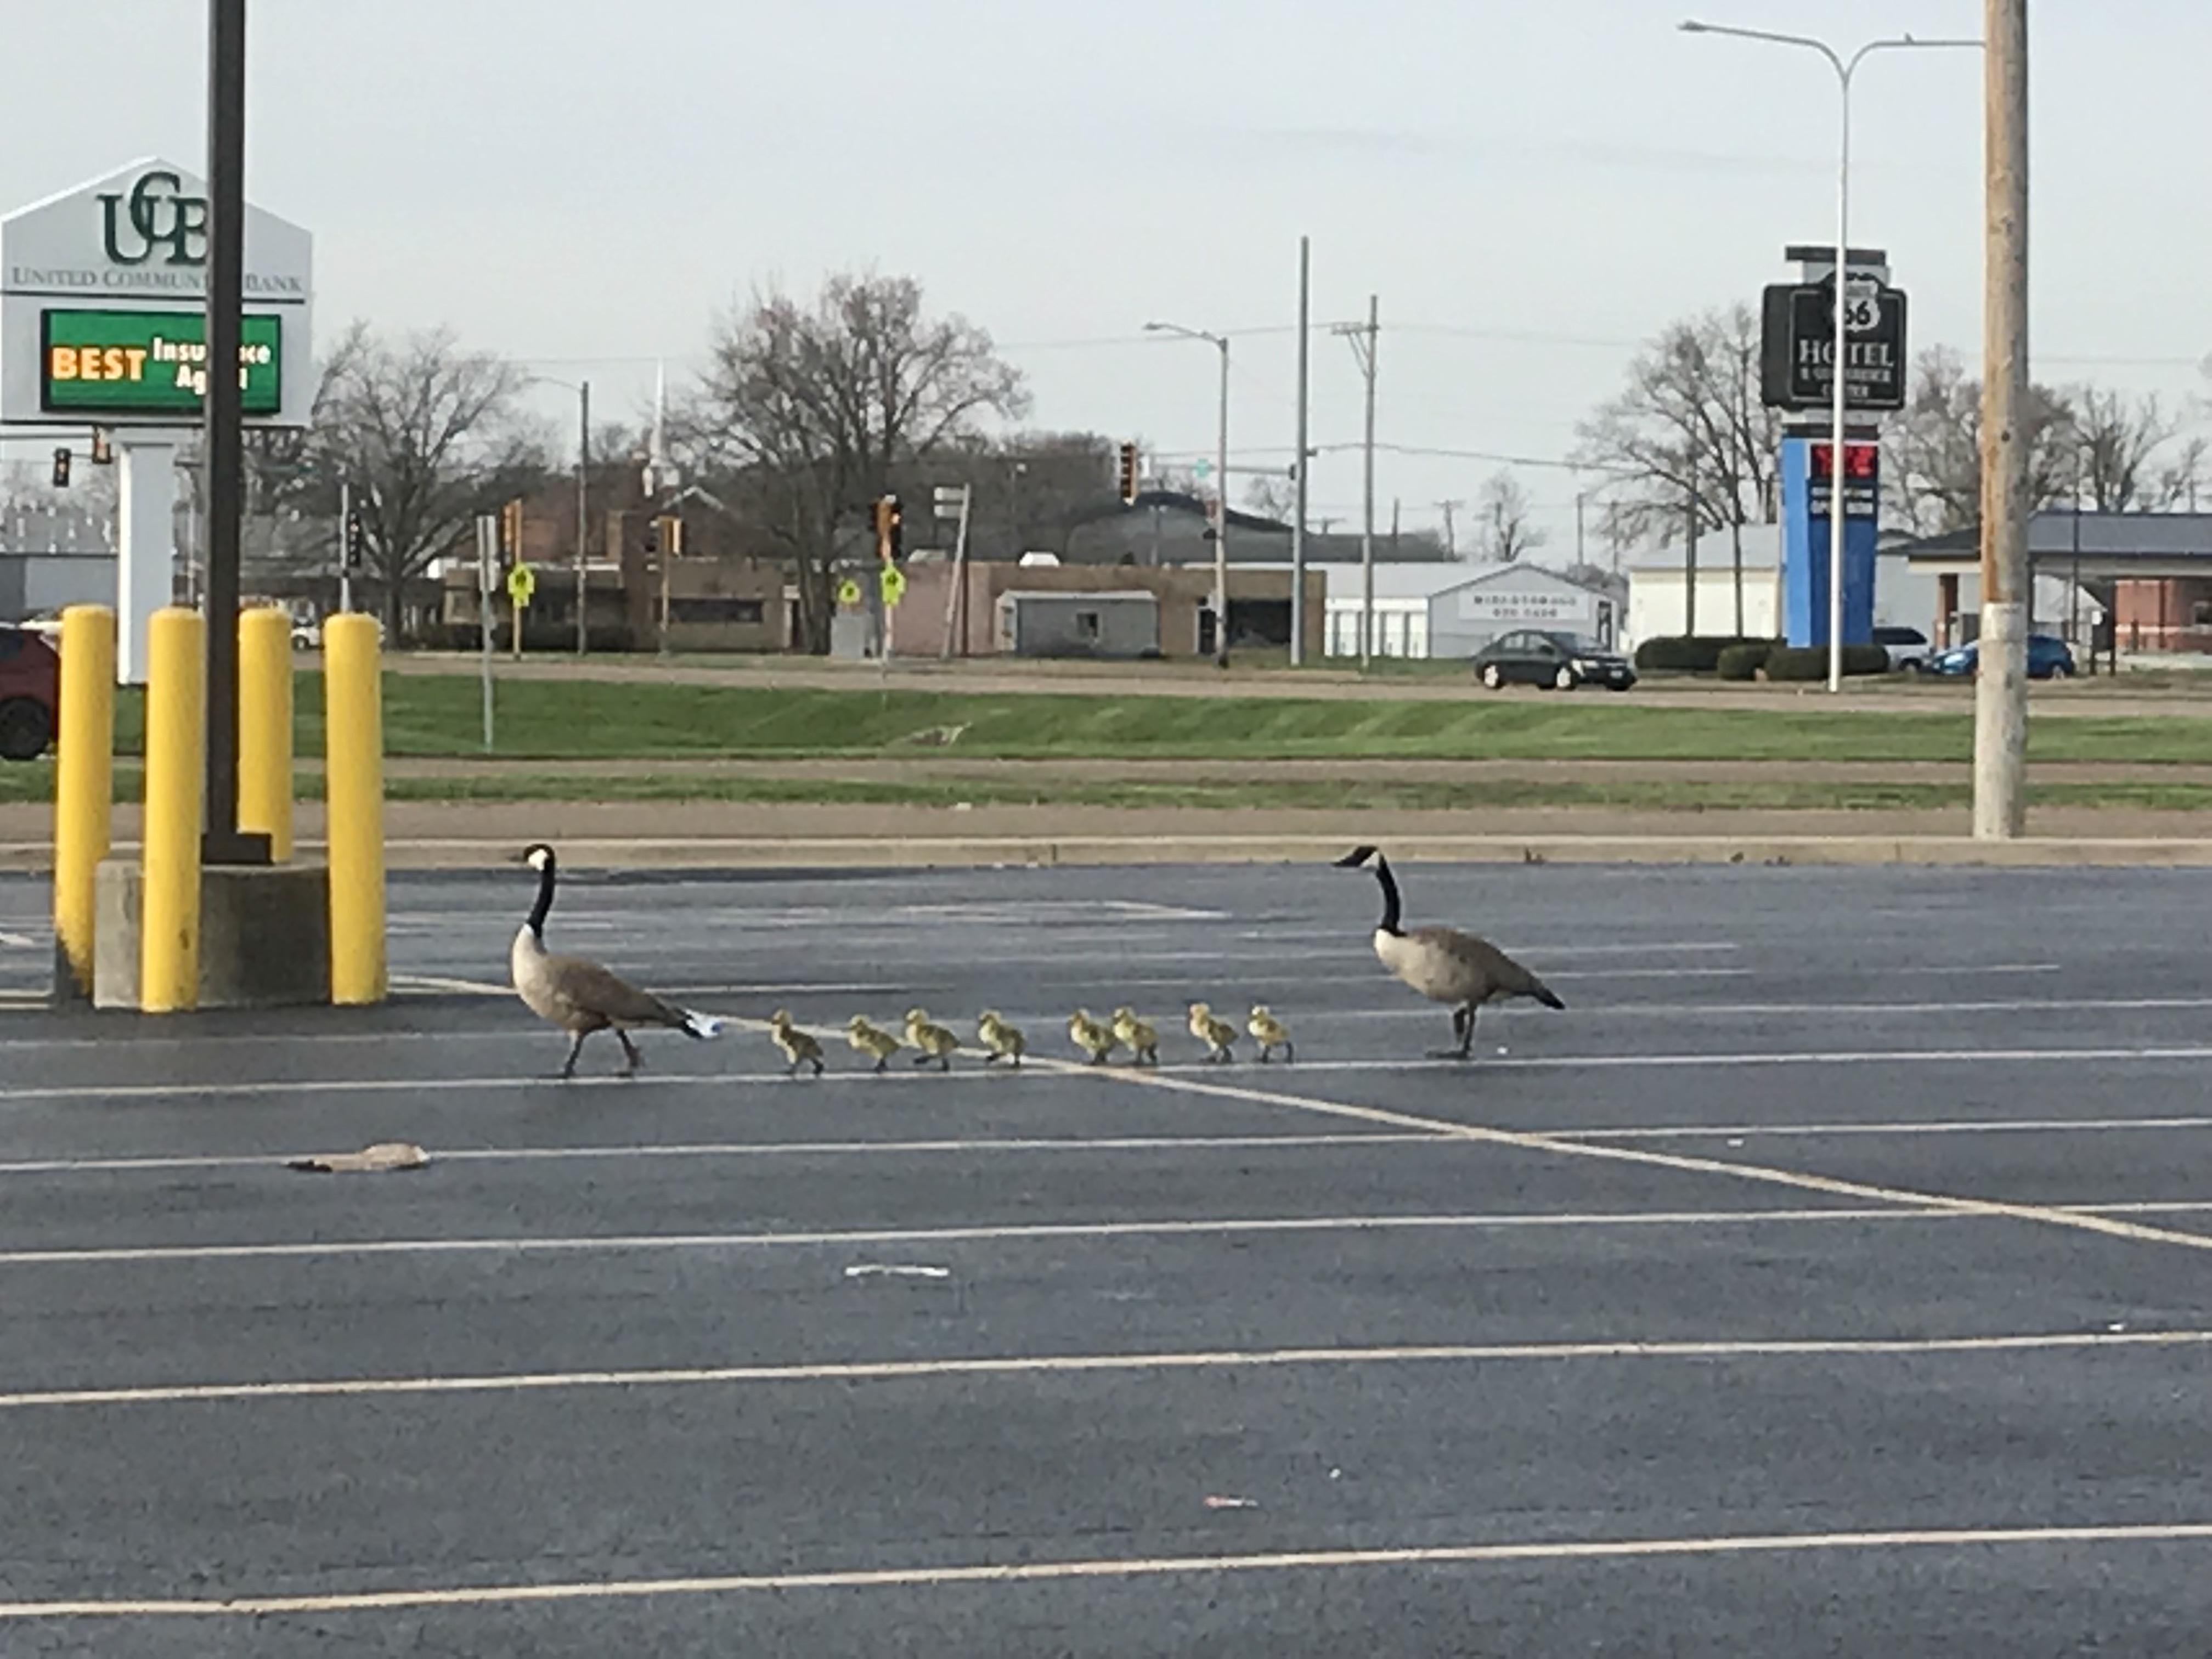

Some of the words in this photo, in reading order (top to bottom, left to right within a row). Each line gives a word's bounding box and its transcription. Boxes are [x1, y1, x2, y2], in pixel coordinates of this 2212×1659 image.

[95, 171, 208, 266] UCB
[13, 267, 97, 286] UNITED
[246, 273, 302, 291] BANK
[52, 347, 147, 381] BEST
